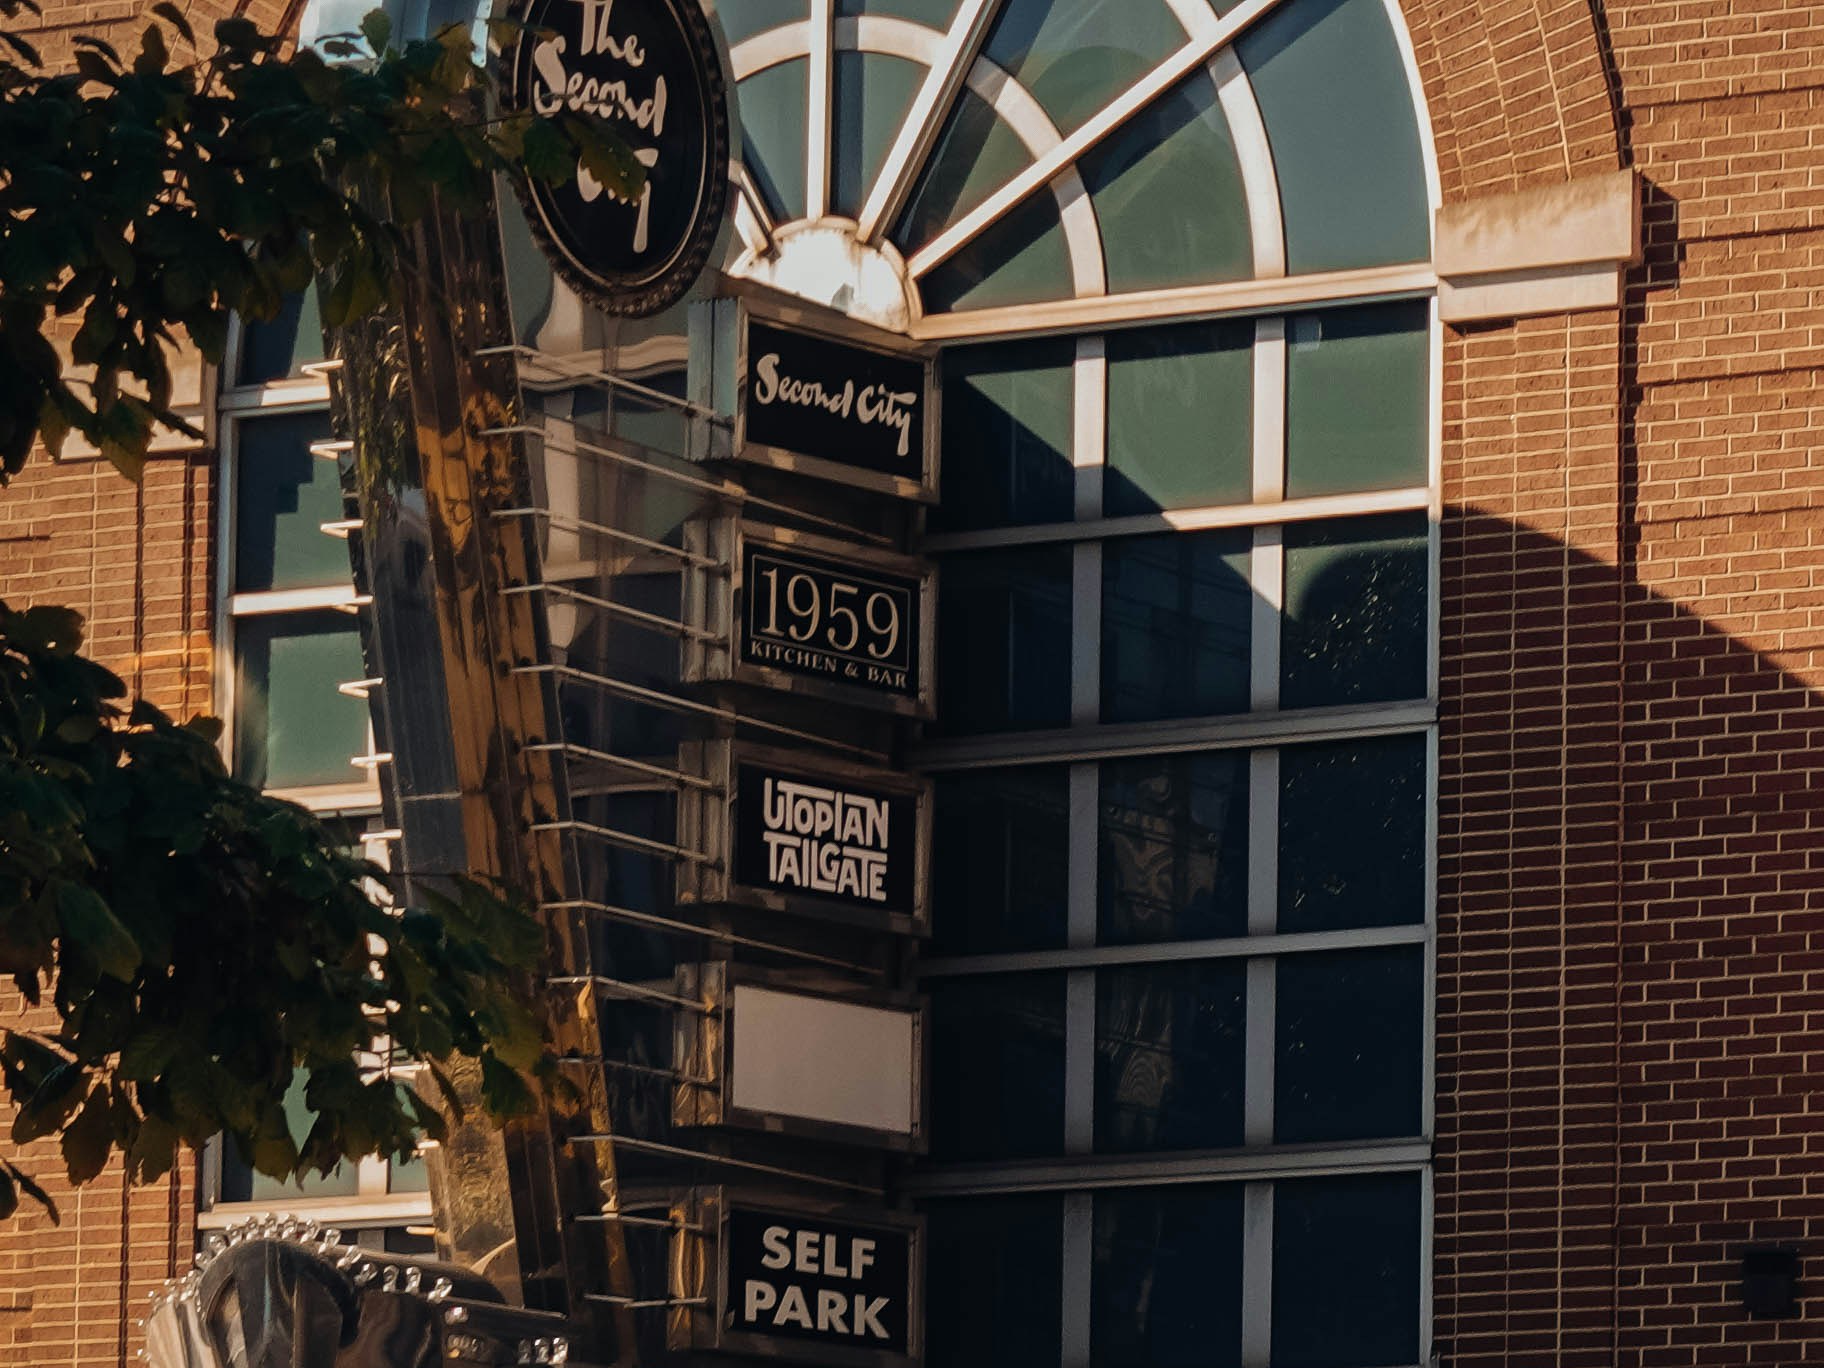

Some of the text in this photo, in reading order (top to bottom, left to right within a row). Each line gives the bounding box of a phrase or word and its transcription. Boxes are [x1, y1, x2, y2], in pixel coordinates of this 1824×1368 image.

[567, 0, 645, 67] The
[534, 36, 667, 137] Second
[755, 353, 917, 456] Second City
[760, 567, 899, 659] 1959
[751, 640, 907, 689] KITCHEN & BAR
[763, 777, 889, 849] UTOPIAN
[763, 831, 888, 901] TAILGATE
[761, 1226, 876, 1279] SELF
[745, 1279, 890, 1339] PARK
